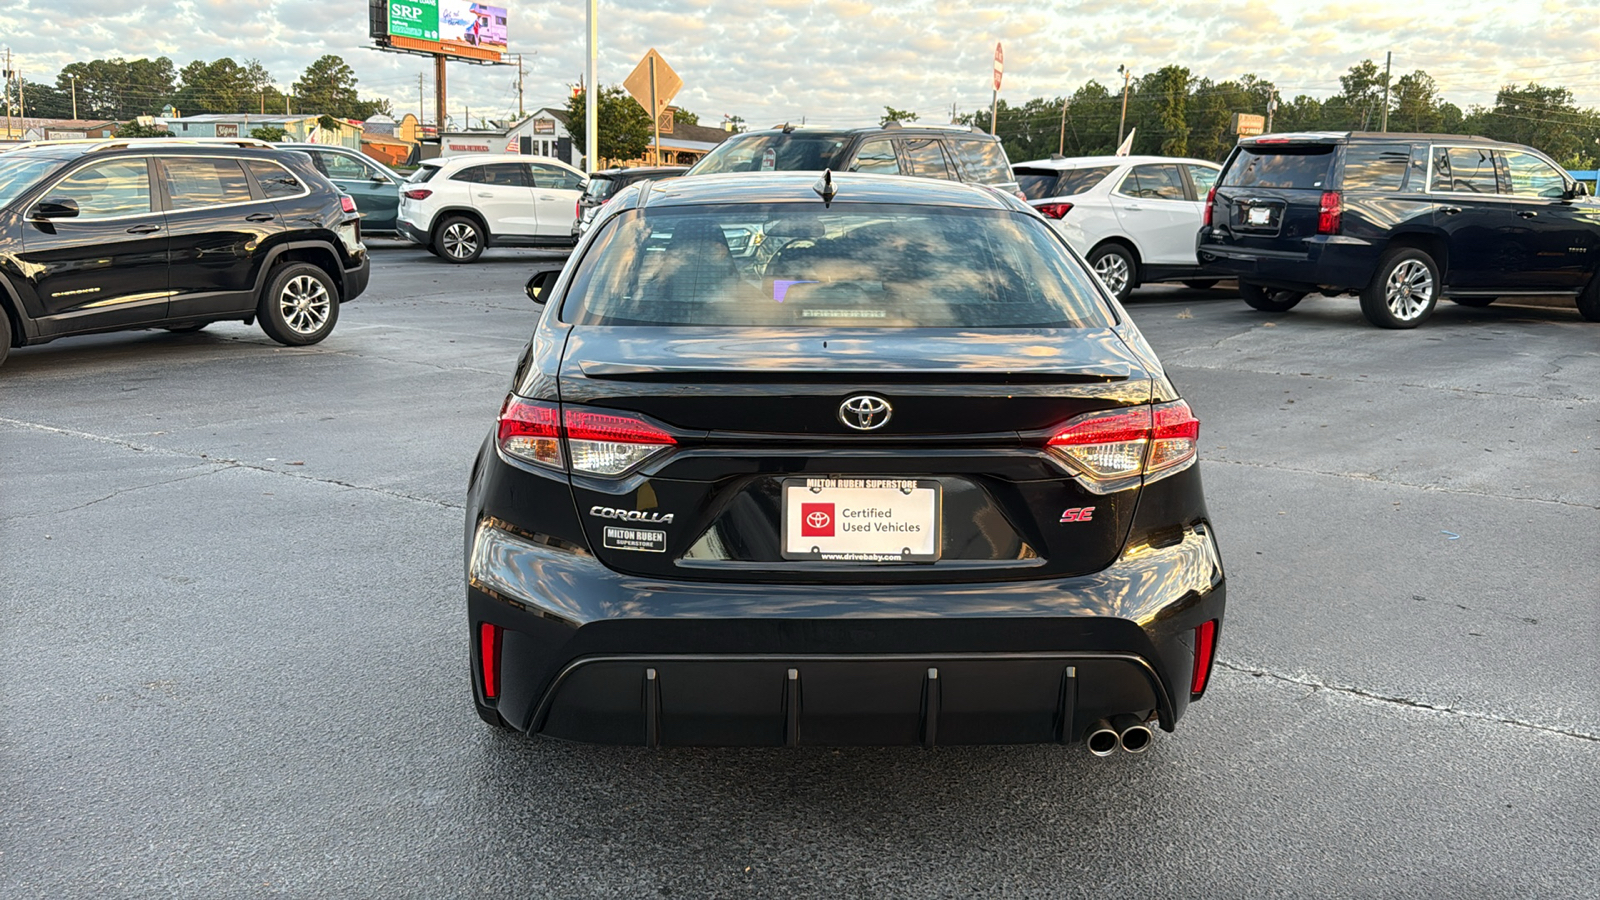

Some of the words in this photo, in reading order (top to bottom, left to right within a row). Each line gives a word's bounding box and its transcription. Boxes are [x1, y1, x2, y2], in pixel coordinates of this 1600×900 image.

[392, 4, 422, 18] SRP
[807, 479, 836, 488] MILTON
[837, 479, 864, 488] RUBEN
[866, 480, 917, 489] SUPERSTORE
[590, 506, 674, 524] COROLLA
[842, 508, 892, 518] Certified
[1060, 507, 1095, 522] SE
[842, 522, 871, 532] Used
[874, 522, 921, 532] Vehicles
[607, 529, 635, 539] MILTON
[636, 531, 663, 542] RUBEN
[616, 539, 654, 547] SUPERSTORE
[821, 553, 902, 562] www.drivebaby.com
